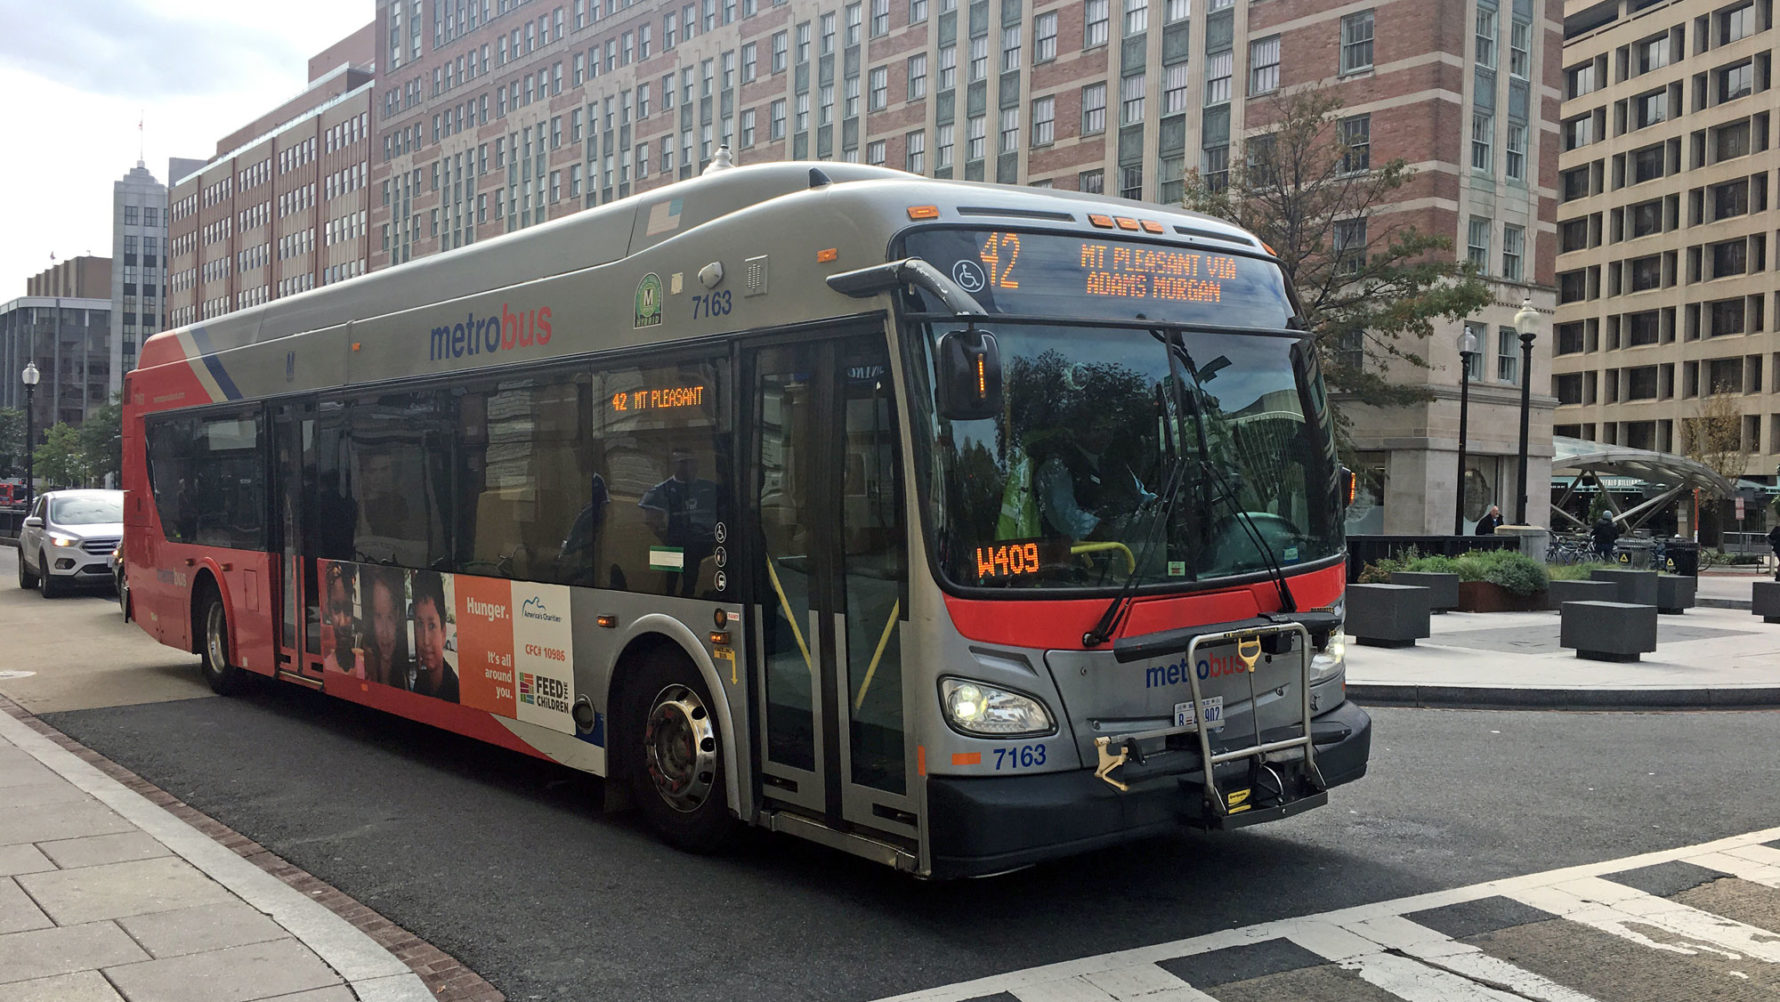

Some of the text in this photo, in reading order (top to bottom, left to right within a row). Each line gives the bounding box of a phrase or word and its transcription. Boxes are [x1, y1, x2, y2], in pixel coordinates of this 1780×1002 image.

[980, 231, 1020, 288] 42
[1081, 244, 1236, 280] MT PLEASANT VIA
[1086, 271, 1221, 302] ADAMS MORGAN
[692, 290, 732, 320] 7163
[430, 303, 552, 360] metrobus
[612, 386, 704, 411] 42 MT PLEASANT
[977, 543, 1039, 578] W409
[466, 597, 509, 622] Hunger.
[487, 651, 512, 667] It's all
[544, 648, 566, 662] 10986
[485, 668, 513, 683] around
[536, 675, 564, 699] FEED
[495, 686, 513, 700] you.
[993, 743, 1047, 771] 7163
